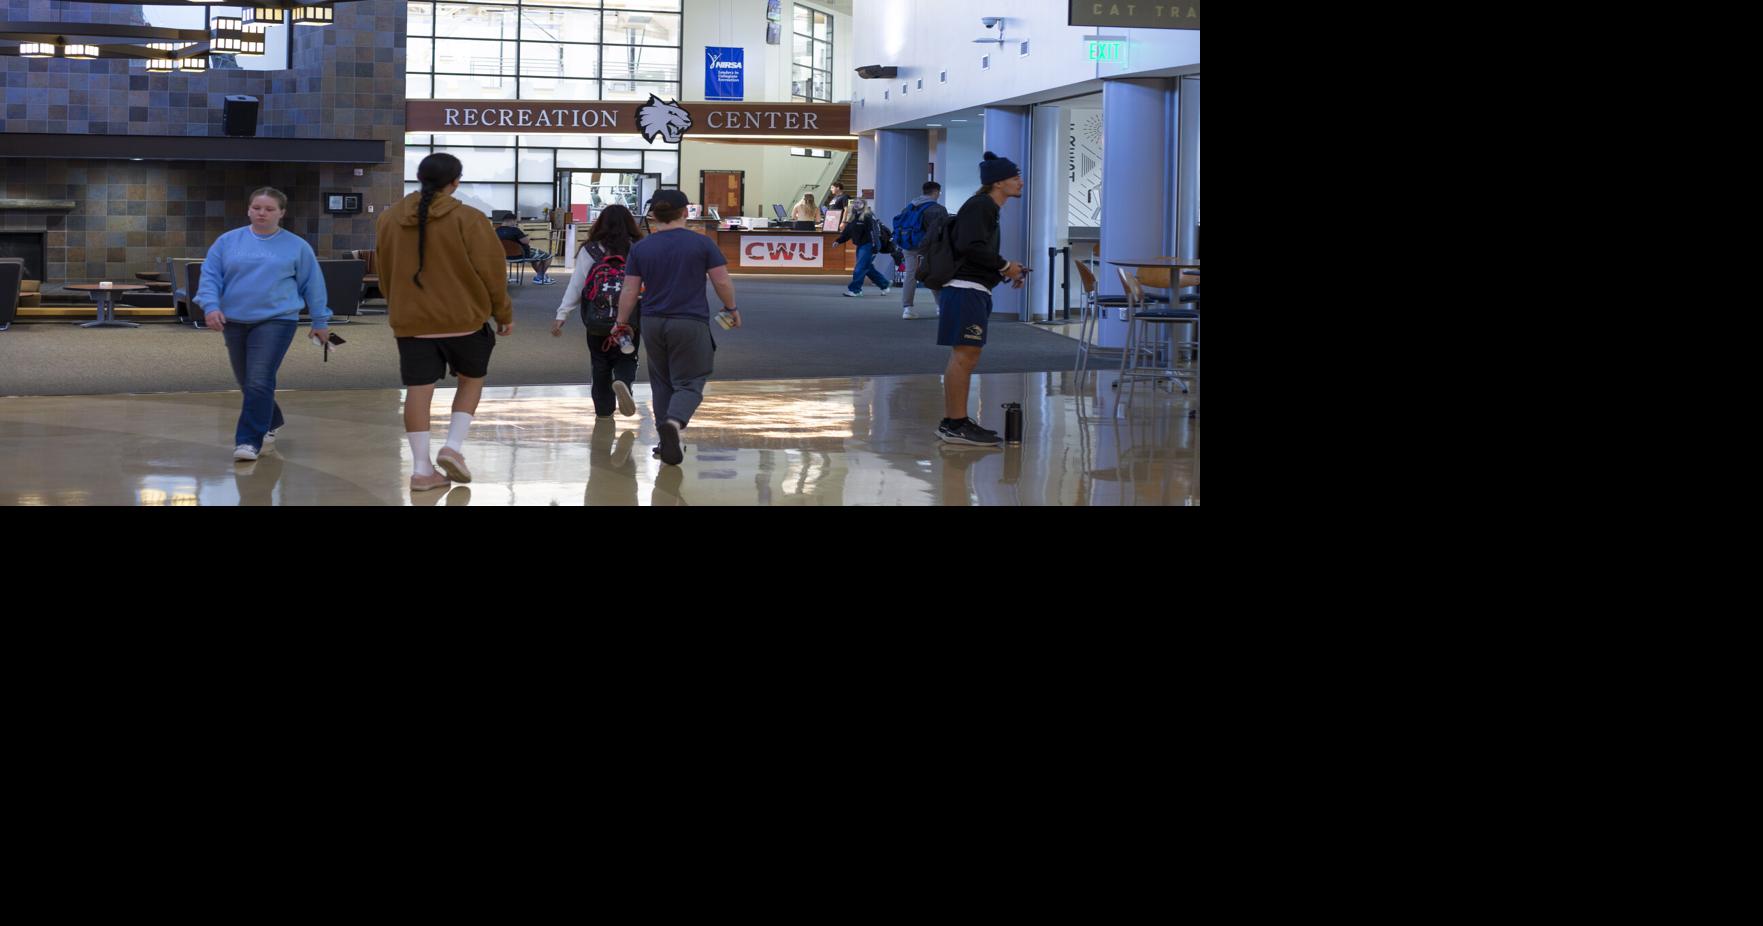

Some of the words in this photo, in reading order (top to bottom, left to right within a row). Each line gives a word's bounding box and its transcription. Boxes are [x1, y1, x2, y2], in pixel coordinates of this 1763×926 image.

[1093, 4, 1136, 16] CAT
[1089, 42, 1120, 60] EXIT
[715, 61, 742, 69] NIRSA
[444, 108, 619, 128] RECREATION
[707, 111, 820, 130] CENTER
[745, 241, 819, 261] CWU
